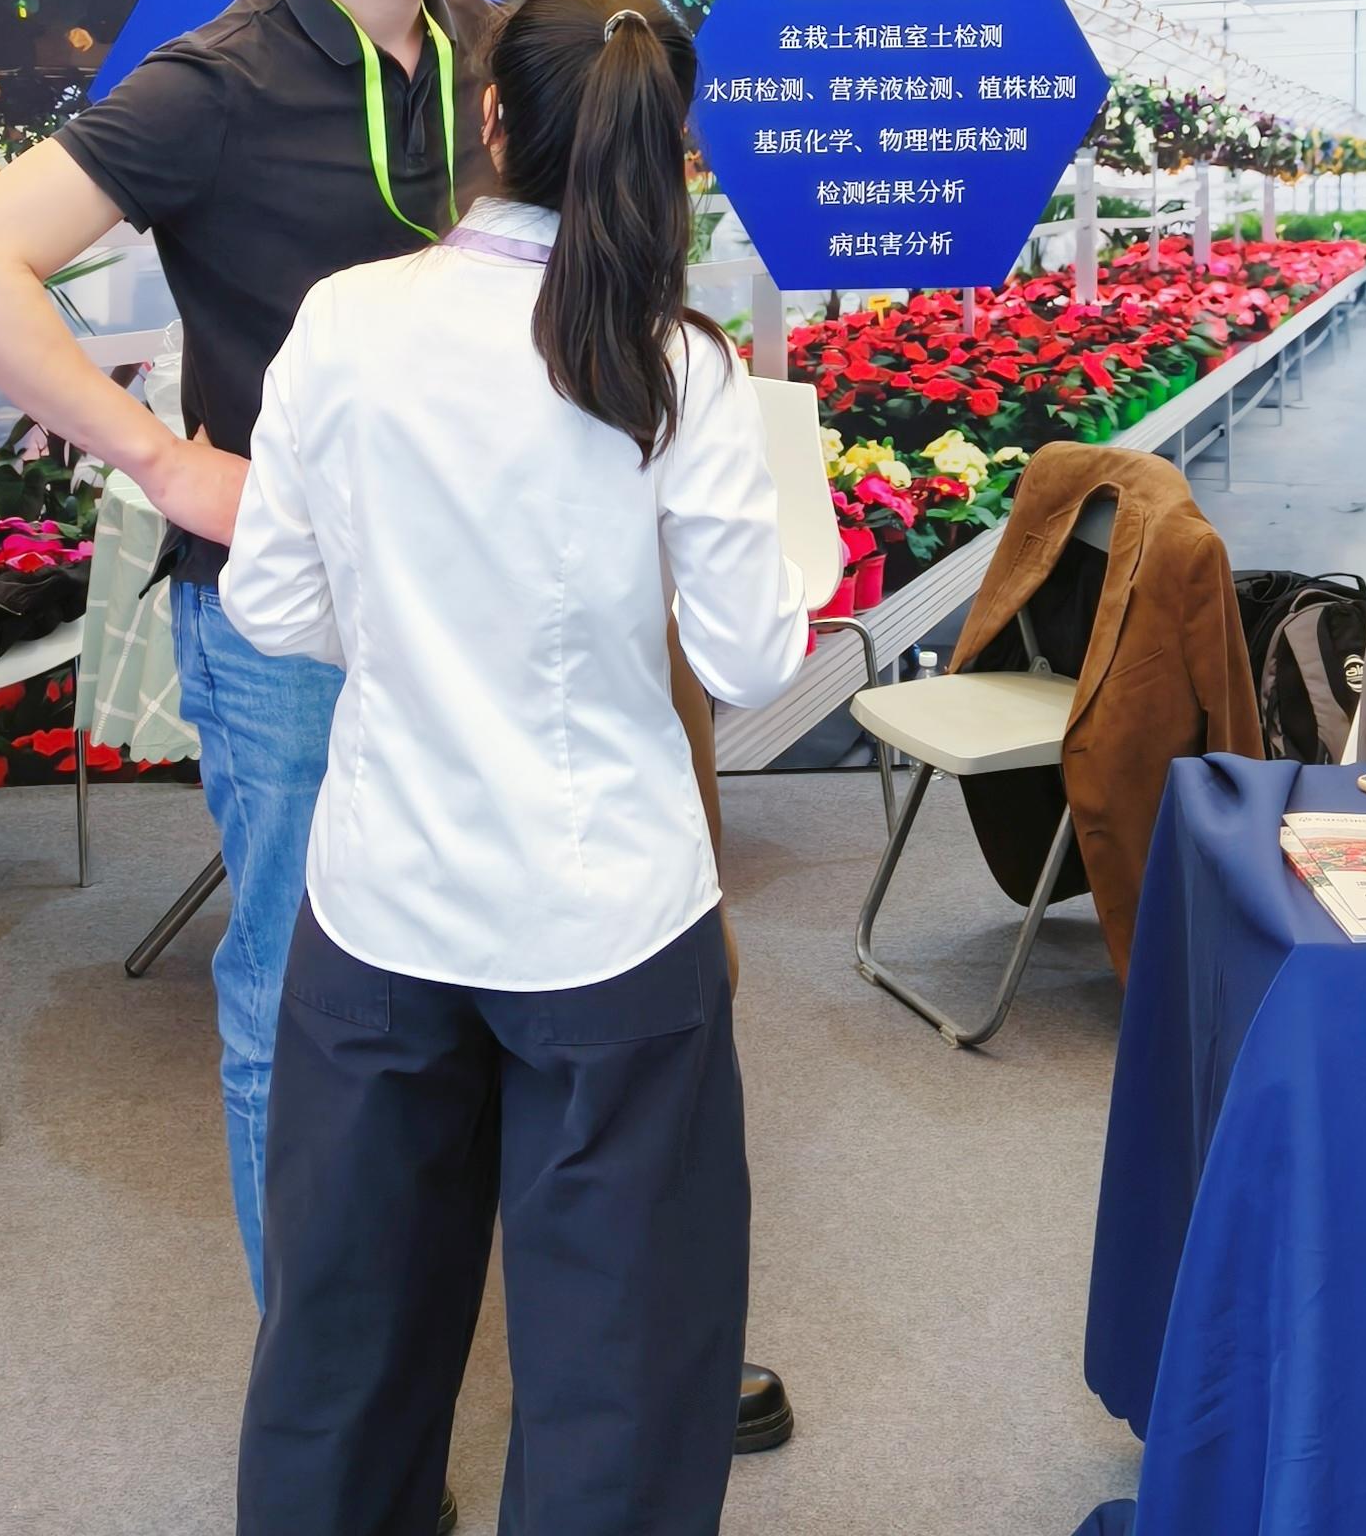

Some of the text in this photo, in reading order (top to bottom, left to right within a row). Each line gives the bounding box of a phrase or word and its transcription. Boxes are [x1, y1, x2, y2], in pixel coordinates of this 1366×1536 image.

[778, 23, 1004, 51] 盆栽土和温室土检测
[703, 74, 1077, 104] 水质检测、营养液检测、植株检测
[753, 126, 1029, 156] 基质化学、物理性质检测
[816, 178, 967, 207] 检测结果分析
[828, 230, 954, 260] 病虫害分析
